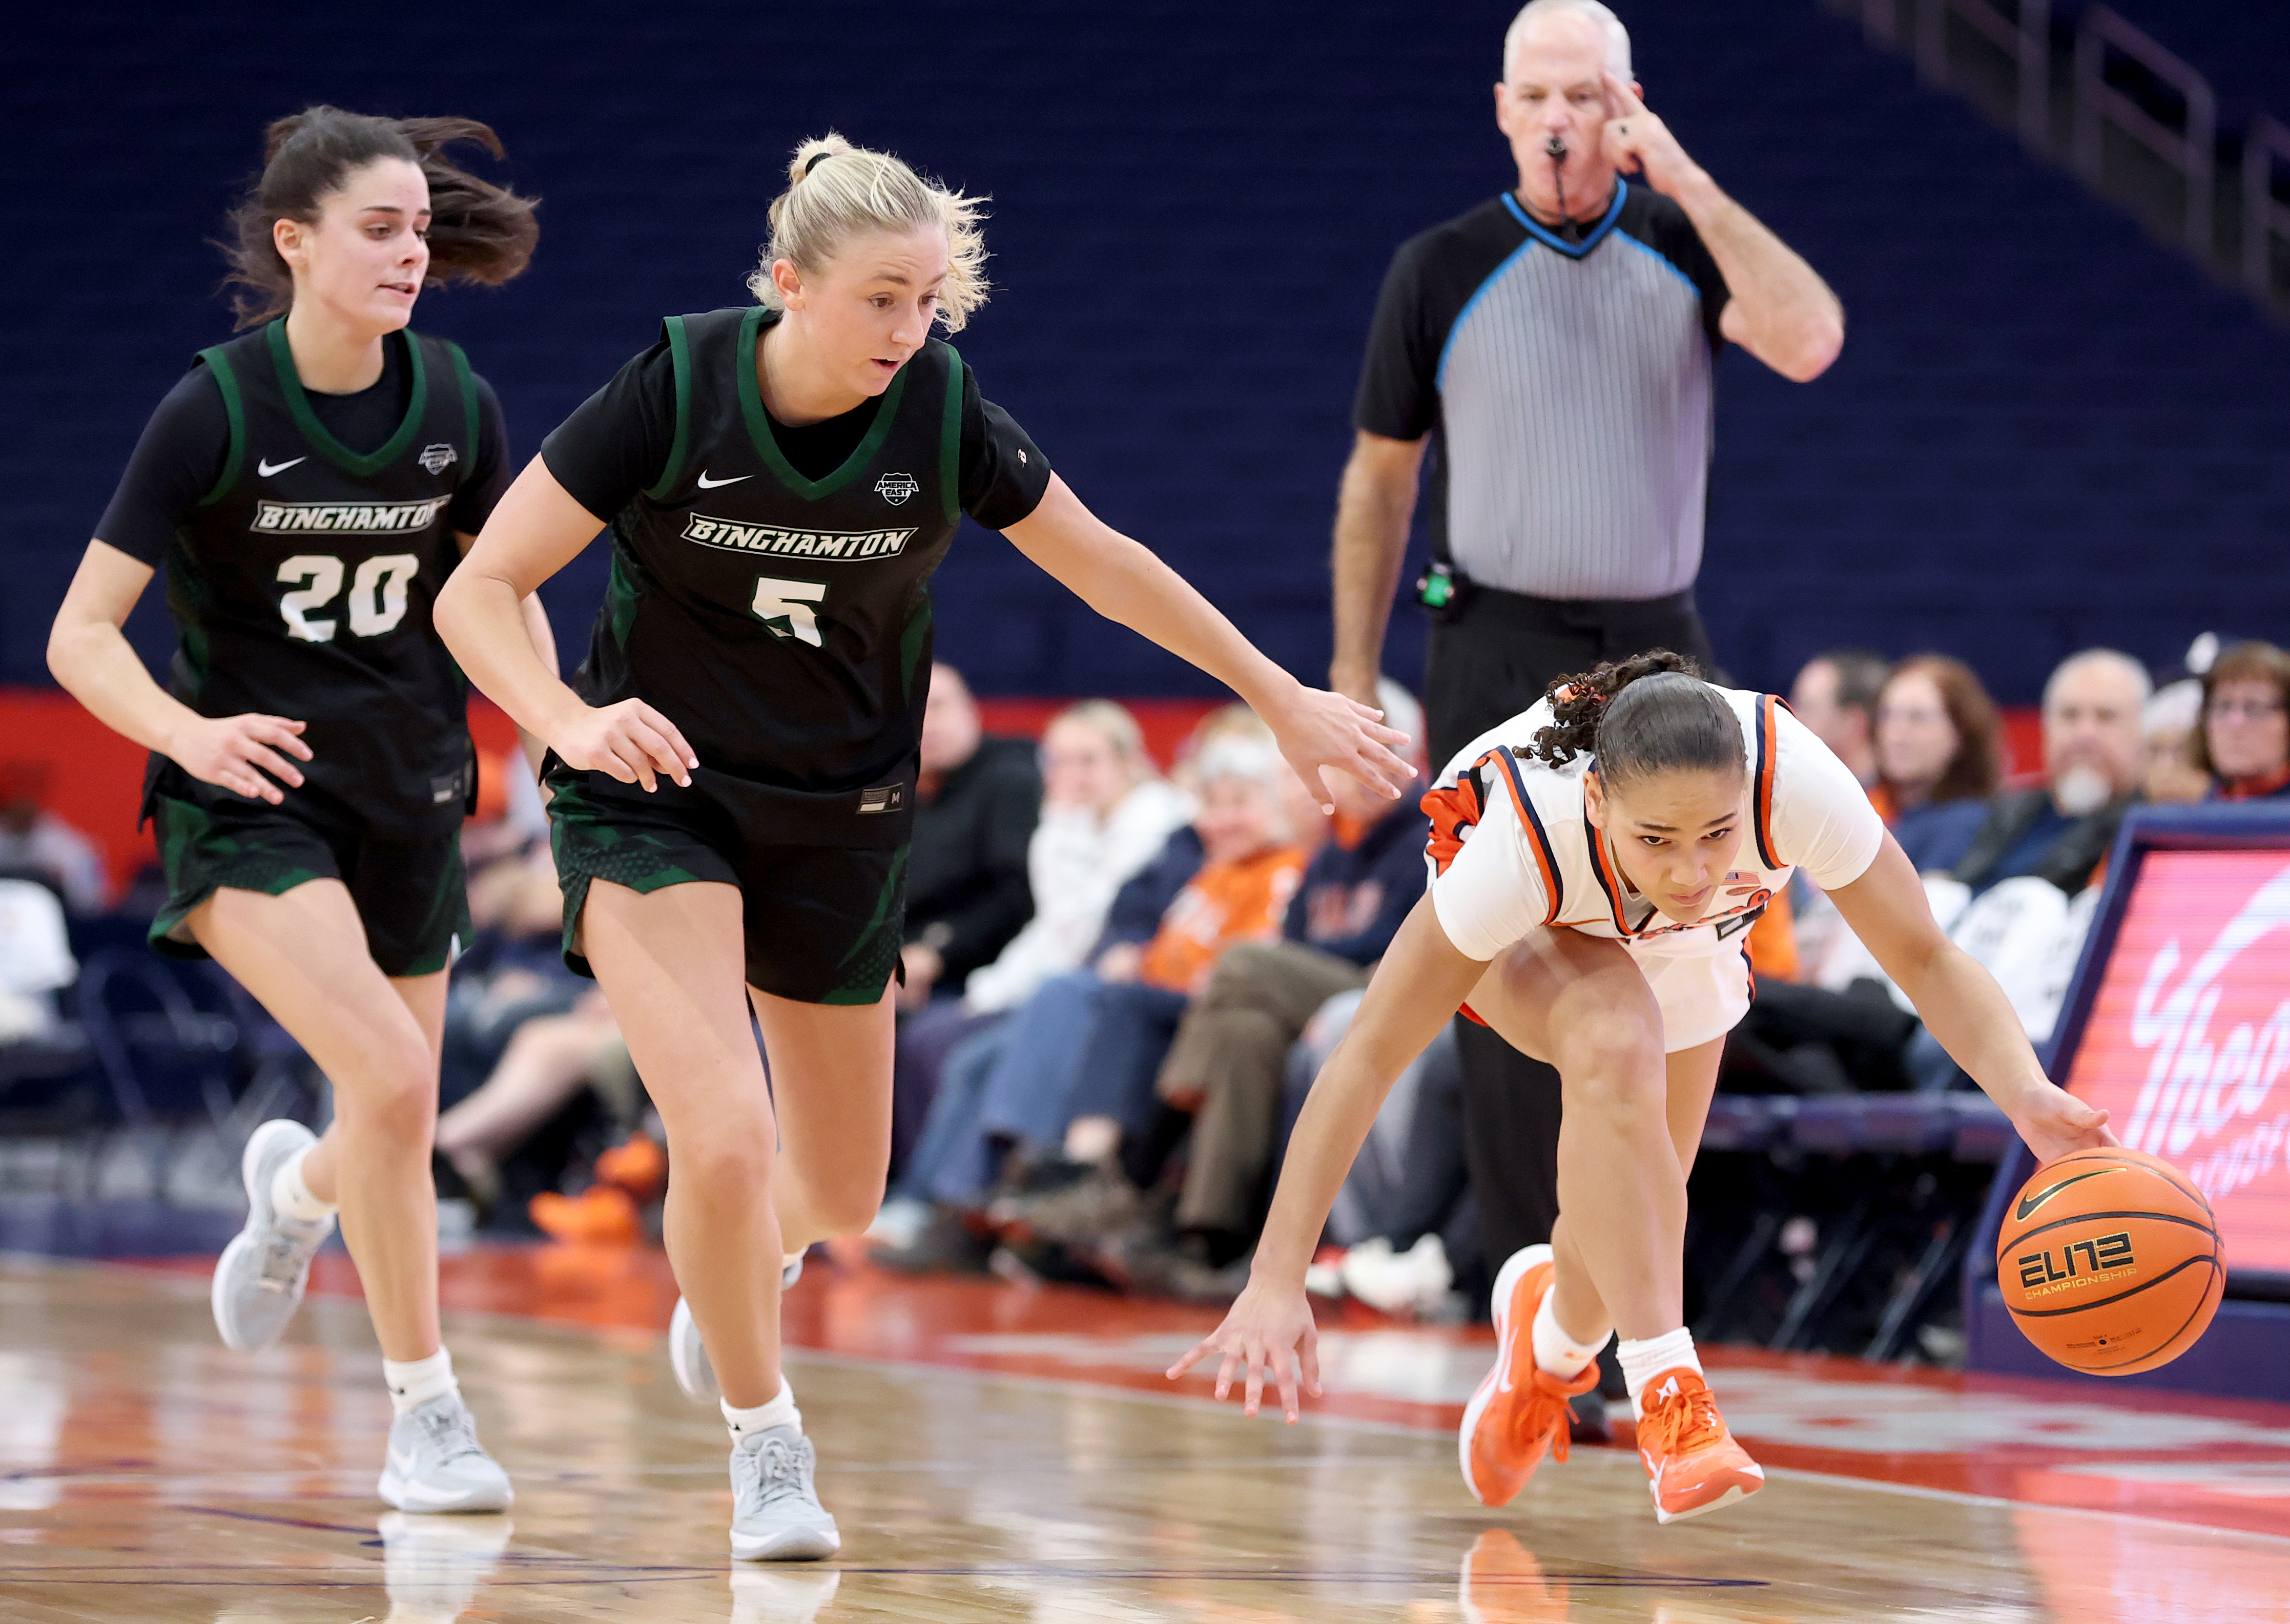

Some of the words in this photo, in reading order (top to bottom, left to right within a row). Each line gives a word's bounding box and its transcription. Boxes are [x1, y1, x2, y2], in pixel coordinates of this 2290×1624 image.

[876, 482, 916, 491] AMERICA
[688, 518, 910, 558] BINGHAMTON
[276, 553, 419, 642] 20
[752, 577, 827, 648] 5
[892, 792, 900, 804] M
[2018, 1231, 2135, 1289] ELITE
[2025, 1267, 2137, 1300] CHAMPIONSHIP
